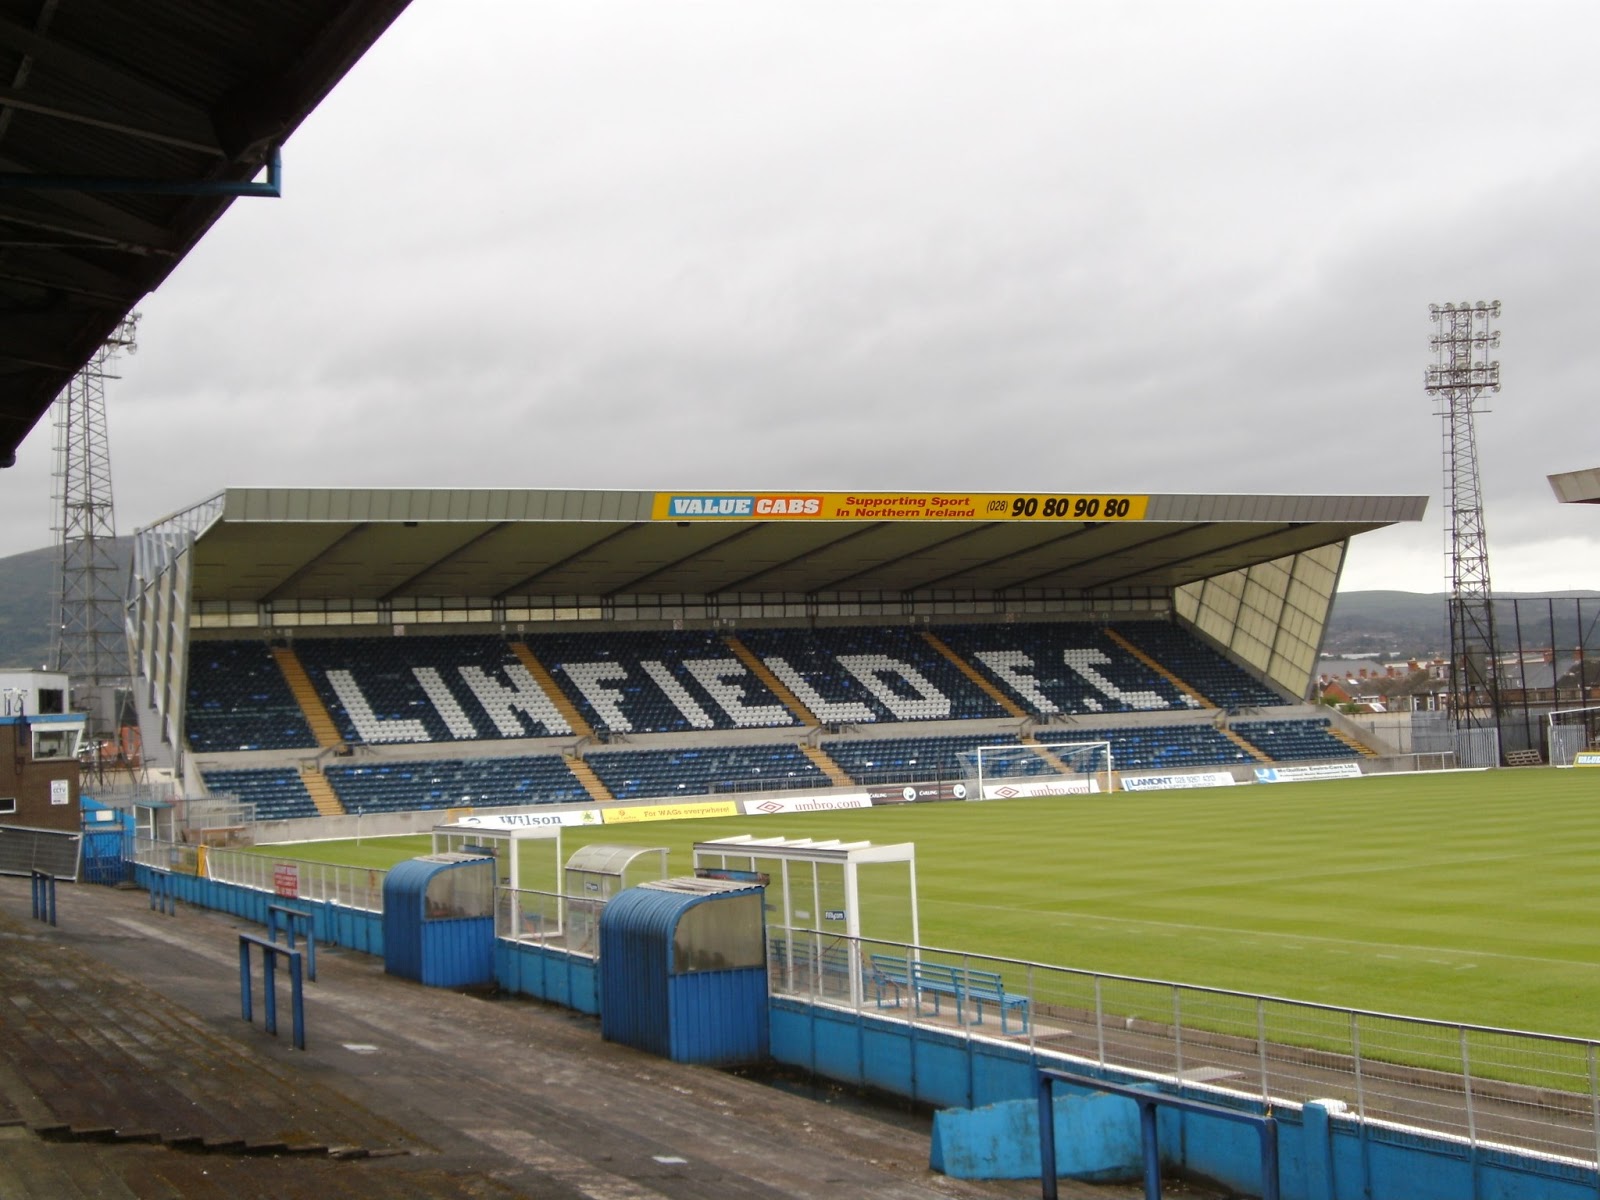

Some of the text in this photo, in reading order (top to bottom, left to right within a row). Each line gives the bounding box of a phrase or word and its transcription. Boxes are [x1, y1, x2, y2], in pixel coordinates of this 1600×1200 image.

[674, 499, 819, 514] VALUE CABS
[845, 496, 970, 508] Supporting Sport
[986, 498, 1130, 517] (028) 90 80 90 80
[836, 508, 975, 517] In Northern Ireland
[1130, 777, 1172, 787] LAMONT
[1030, 785, 1090, 797] umbro.com
[683, 806, 730, 815] everywhere!
[794, 799, 861, 811] umbro.com
[499, 815, 562, 826] Wilson
